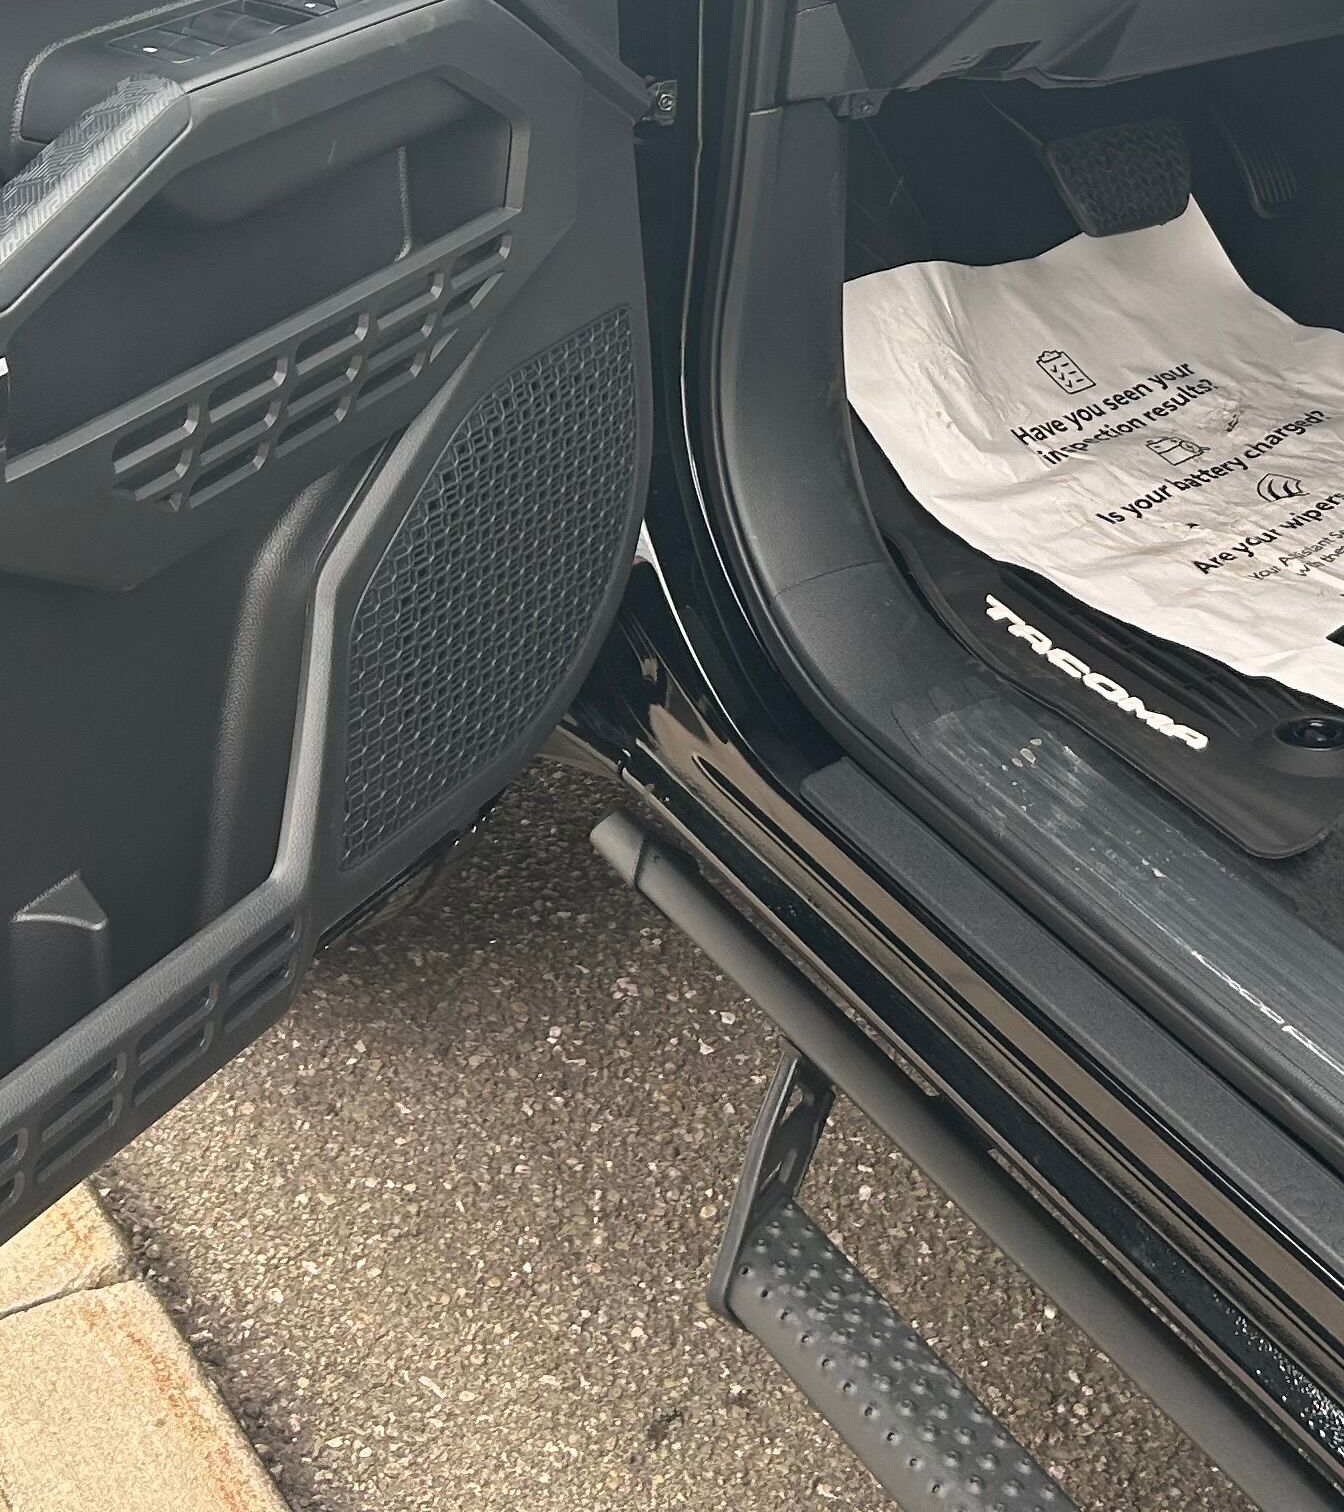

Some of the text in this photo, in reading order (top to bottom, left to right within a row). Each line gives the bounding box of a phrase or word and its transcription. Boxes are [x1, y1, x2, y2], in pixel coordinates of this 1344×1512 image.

[1010, 363, 1195, 445] Have you seen your
[1037, 378, 1219, 465] inspection results?
[1095, 410, 1331, 524] Is your battery charged?
[1193, 549, 1238, 574] Are
[1232, 527, 1284, 557] your
[985, 593, 1209, 750] TACOMA
